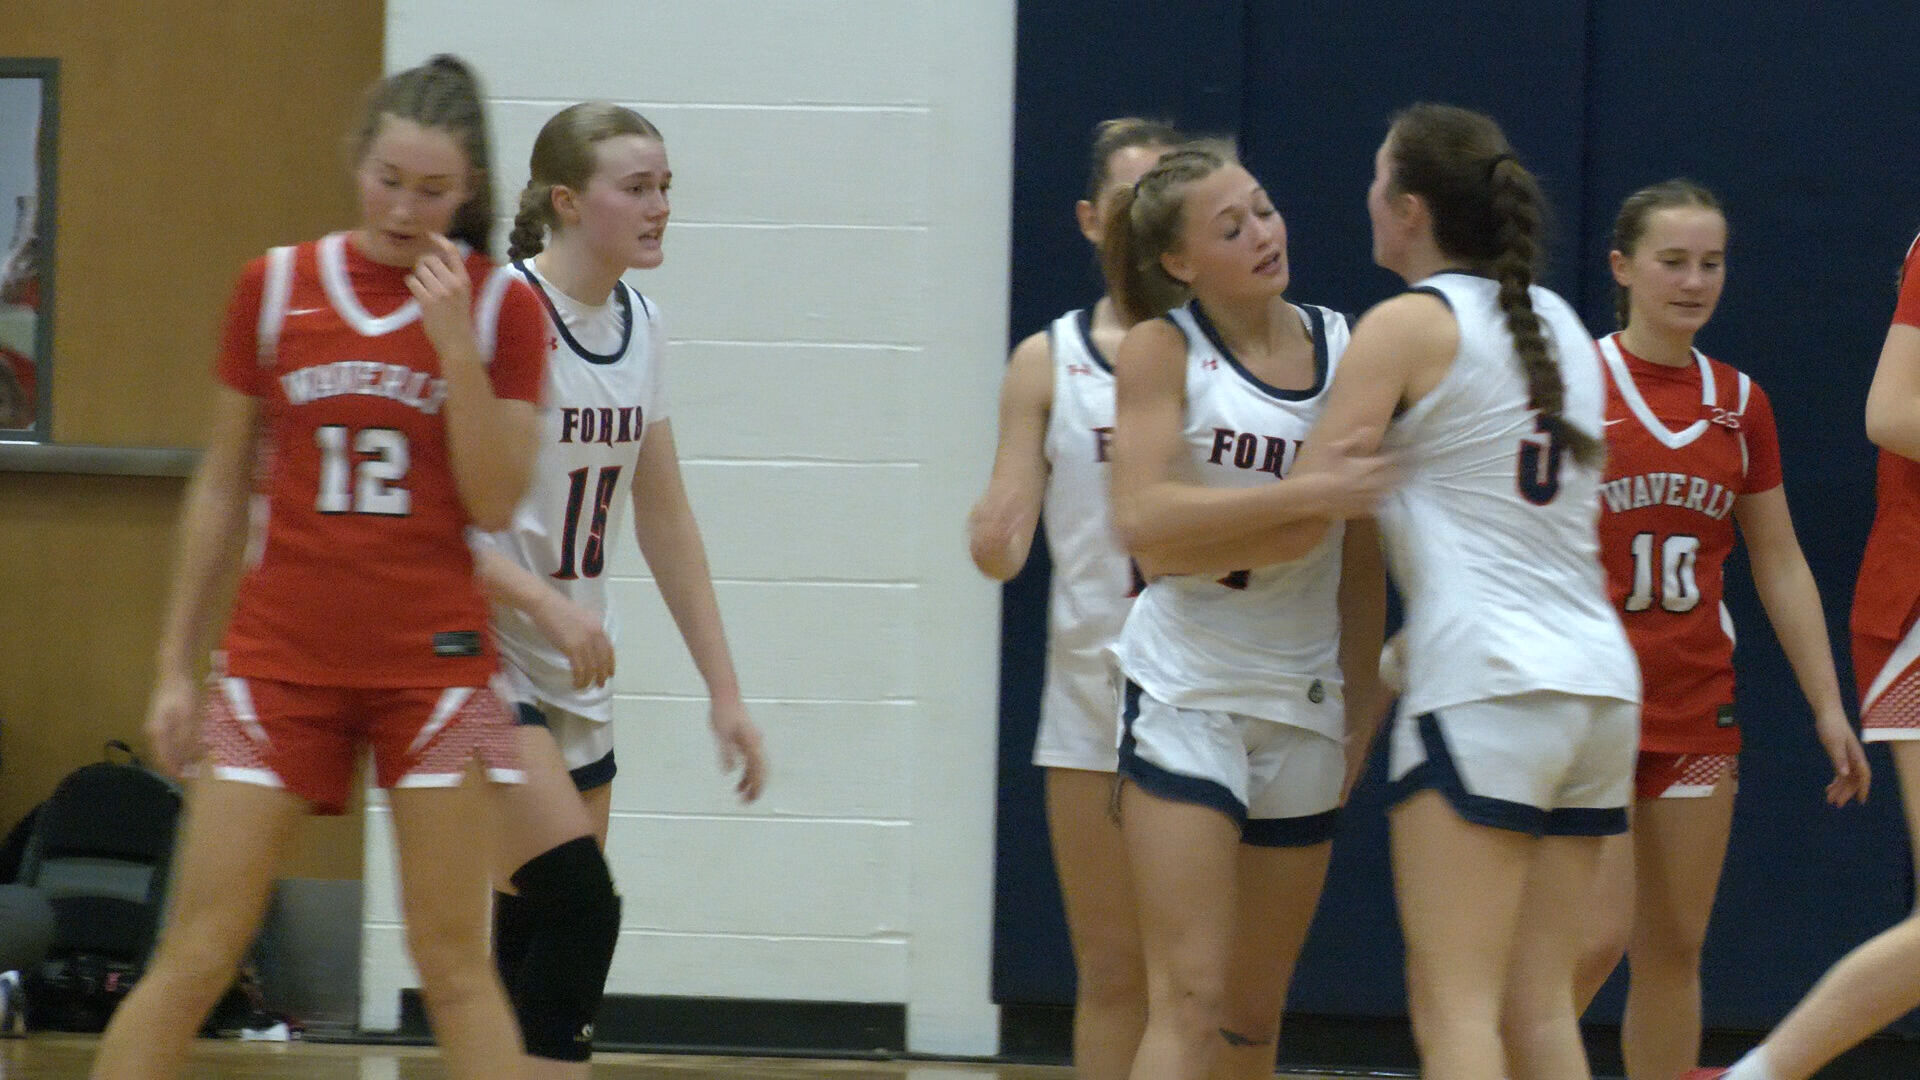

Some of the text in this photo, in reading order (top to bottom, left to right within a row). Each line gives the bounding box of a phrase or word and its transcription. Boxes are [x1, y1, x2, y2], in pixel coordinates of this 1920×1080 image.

[1711, 408, 1740, 429] 25
[312, 424, 412, 517] 12
[549, 465, 623, 581] 15
[1624, 532, 1701, 614] 10
